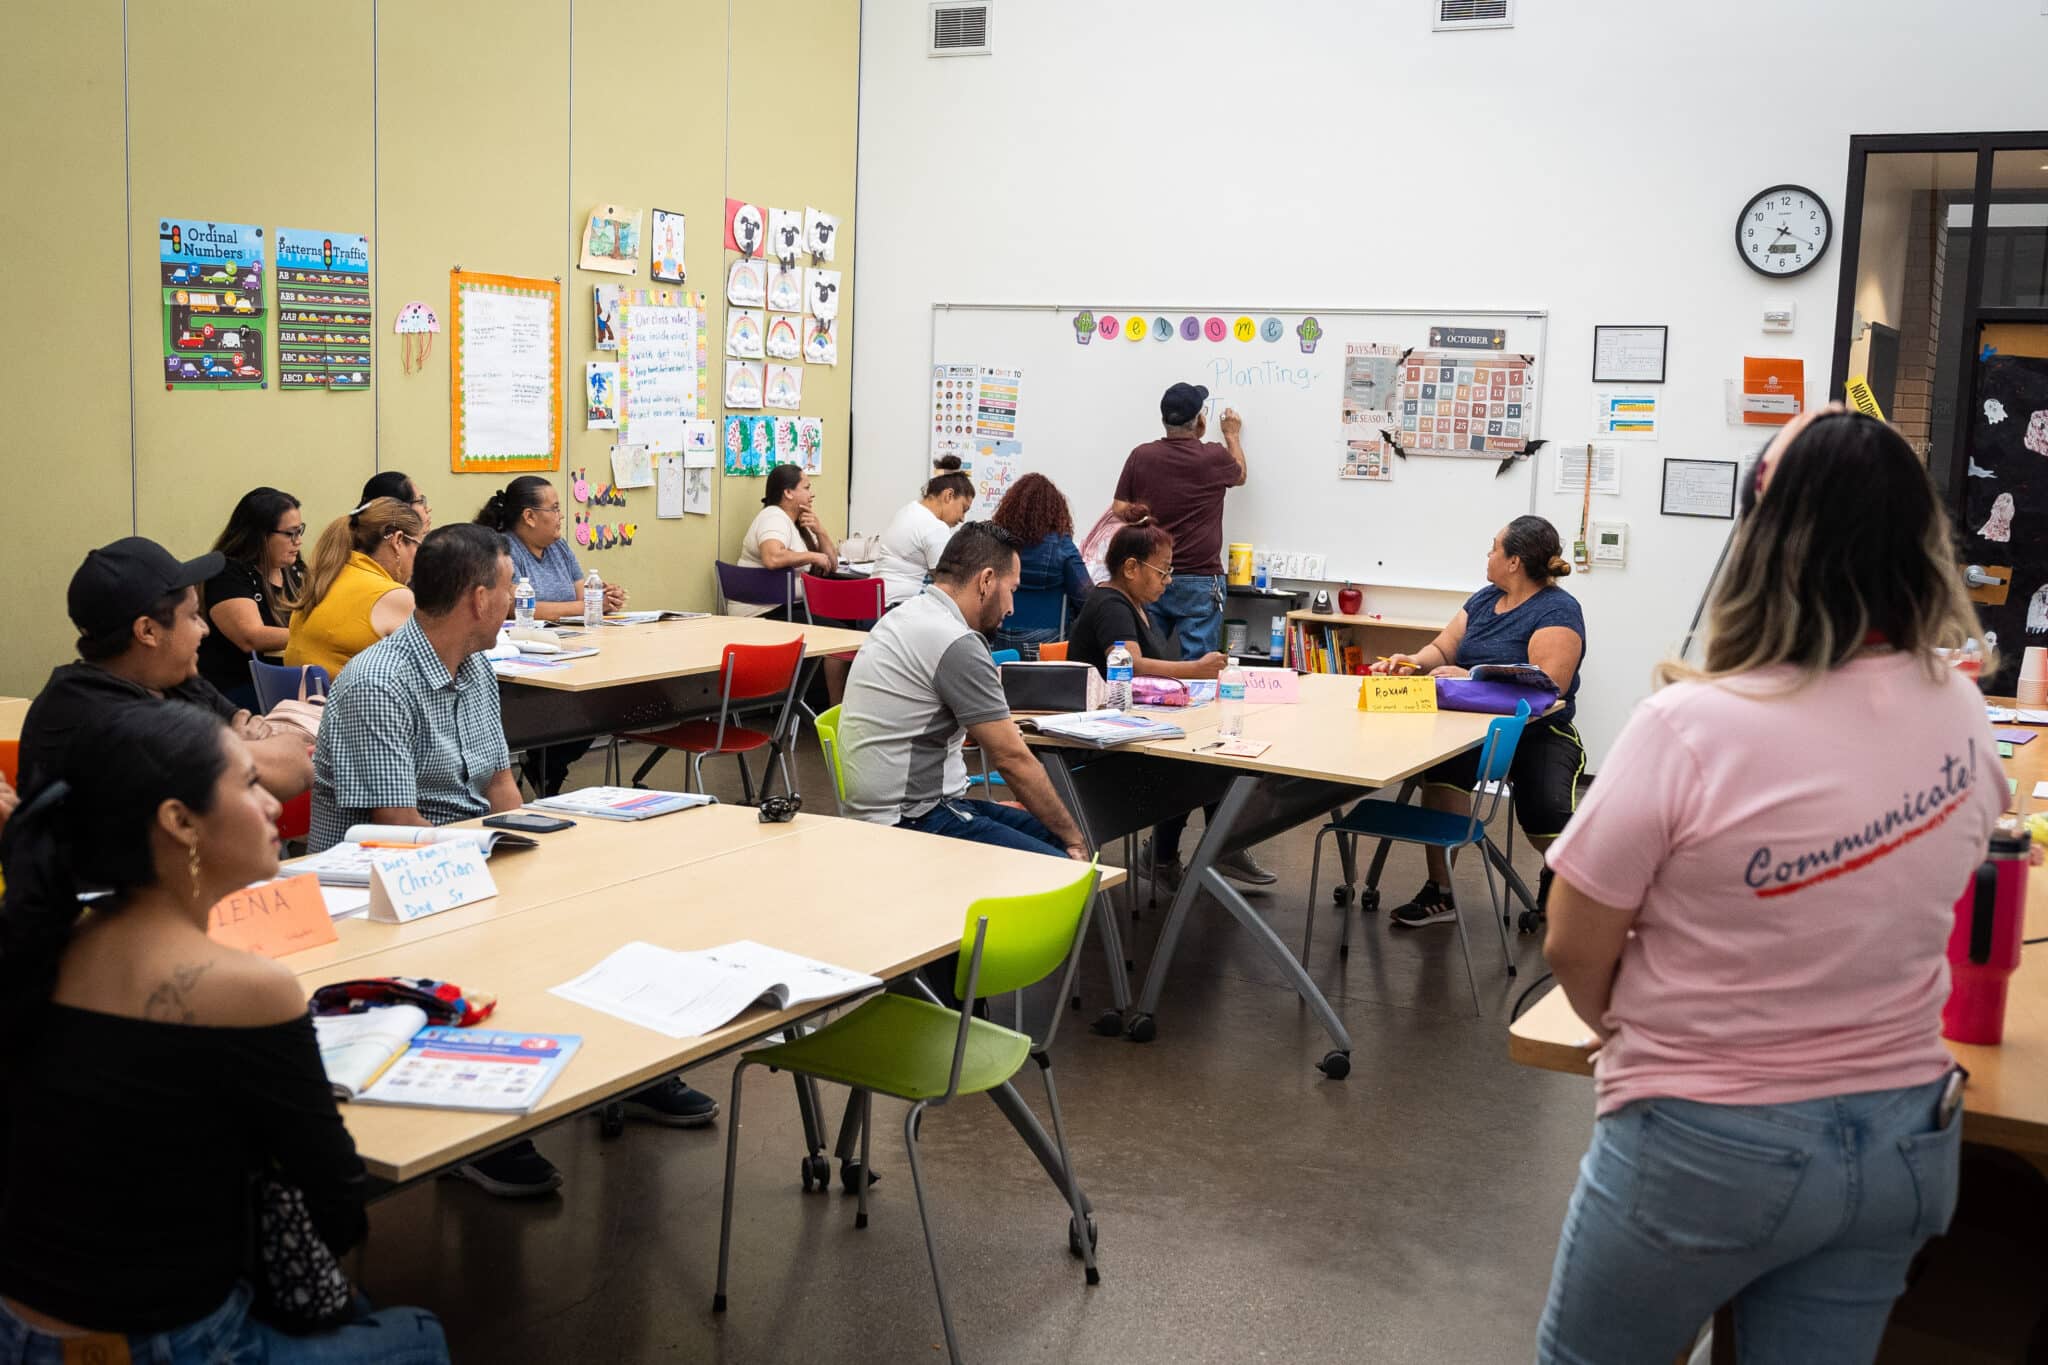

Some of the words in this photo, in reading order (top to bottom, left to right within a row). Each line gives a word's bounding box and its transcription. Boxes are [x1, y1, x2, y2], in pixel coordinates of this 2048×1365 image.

[1781, 197, 1791, 205] 12
[1767, 202, 1774, 210] 11
[1755, 213, 1764, 221] 10
[1810, 211, 1816, 219] 2
[1748, 229, 1754, 237] 9
[1815, 227, 1820, 235] 3
[188, 227, 238, 244] Ordinal
[184, 244, 242, 260] Numbers
[279, 242, 322, 256] Patterns
[333, 247, 366, 260] Traffic
[1752, 244, 1758, 252] 8
[1765, 255, 1769, 263] 7
[1780, 259, 1785, 267] 6
[279, 272, 289, 280] AB
[280, 292, 295, 301] ABB
[281, 312, 297, 321] AAB
[281, 333, 296, 341] ABA
[1447, 335, 1488, 344] OCTOBER
[282, 354, 297, 362] ABC
[283, 374, 302, 382] ABCD
[1411, 370, 1415, 378] 1
[1445, 370, 1450, 378] 3
[1514, 374, 1520, 382] 7
[1494, 389, 1502, 397] 13
[1440, 404, 1448, 412] 17
[1475, 407, 1483, 415] 19
[1490, 424, 1500, 432] 27
[980, 481, 1006, 501] Spa
[1744, 737, 1977, 888] Communicate!
